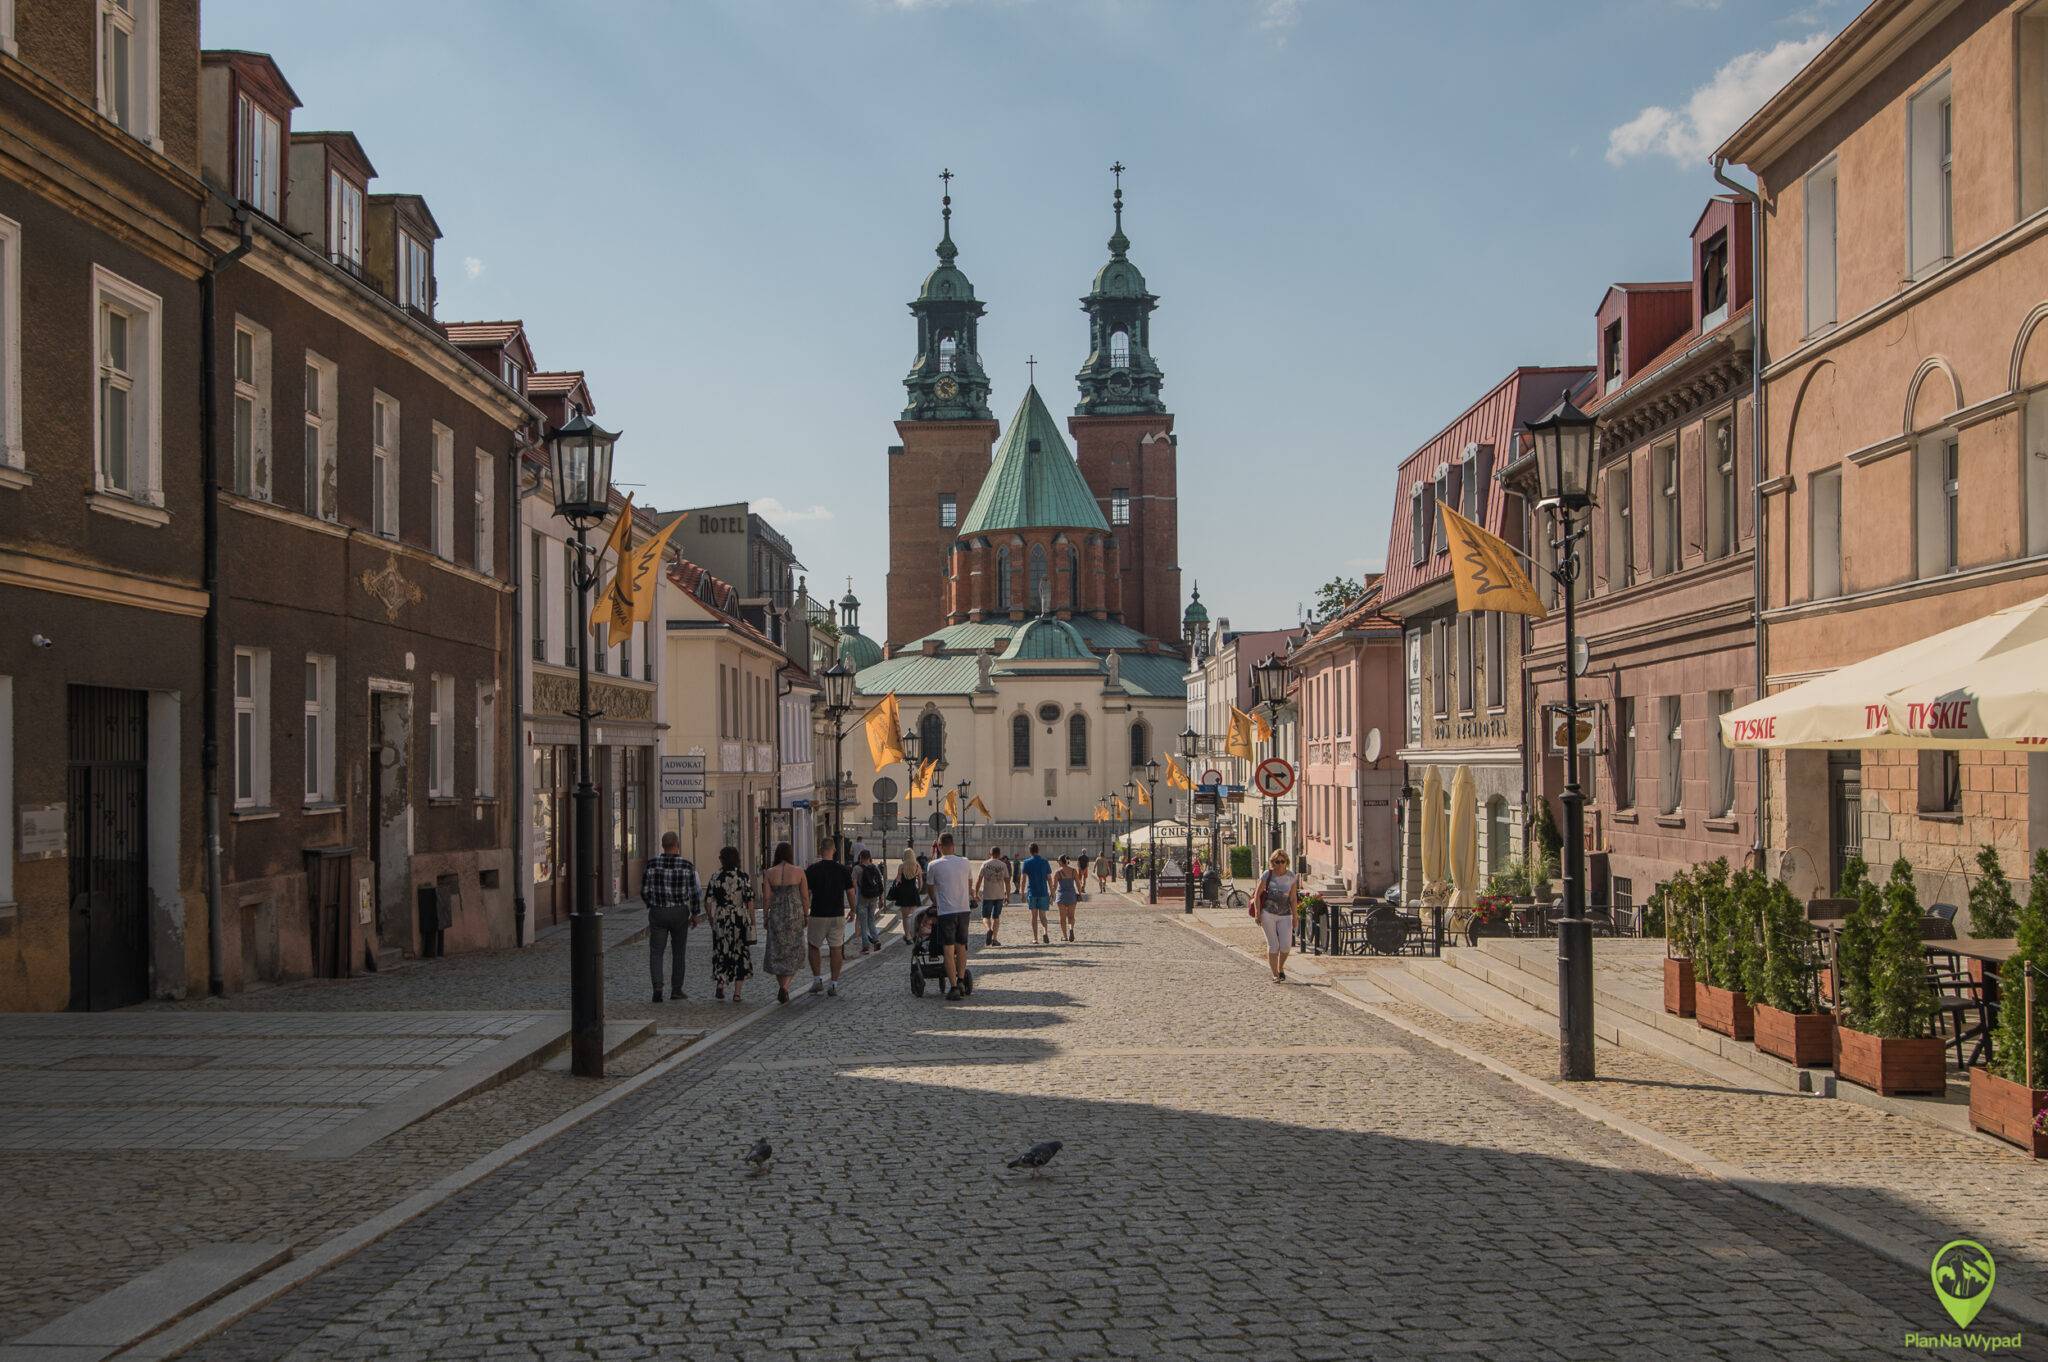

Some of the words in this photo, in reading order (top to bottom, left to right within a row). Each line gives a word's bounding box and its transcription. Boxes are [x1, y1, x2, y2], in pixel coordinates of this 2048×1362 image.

[699, 514, 745, 534] HOTEL
[1907, 700, 1971, 730] TYSKIE
[1734, 716, 1777, 741] TYSKIE
[664, 760, 702, 769] ADWOKAT
[664, 778, 703, 786] NOTARIUSZ
[664, 796, 703, 804] MEDIATOR
[1160, 827, 1210, 837] GNIENO
